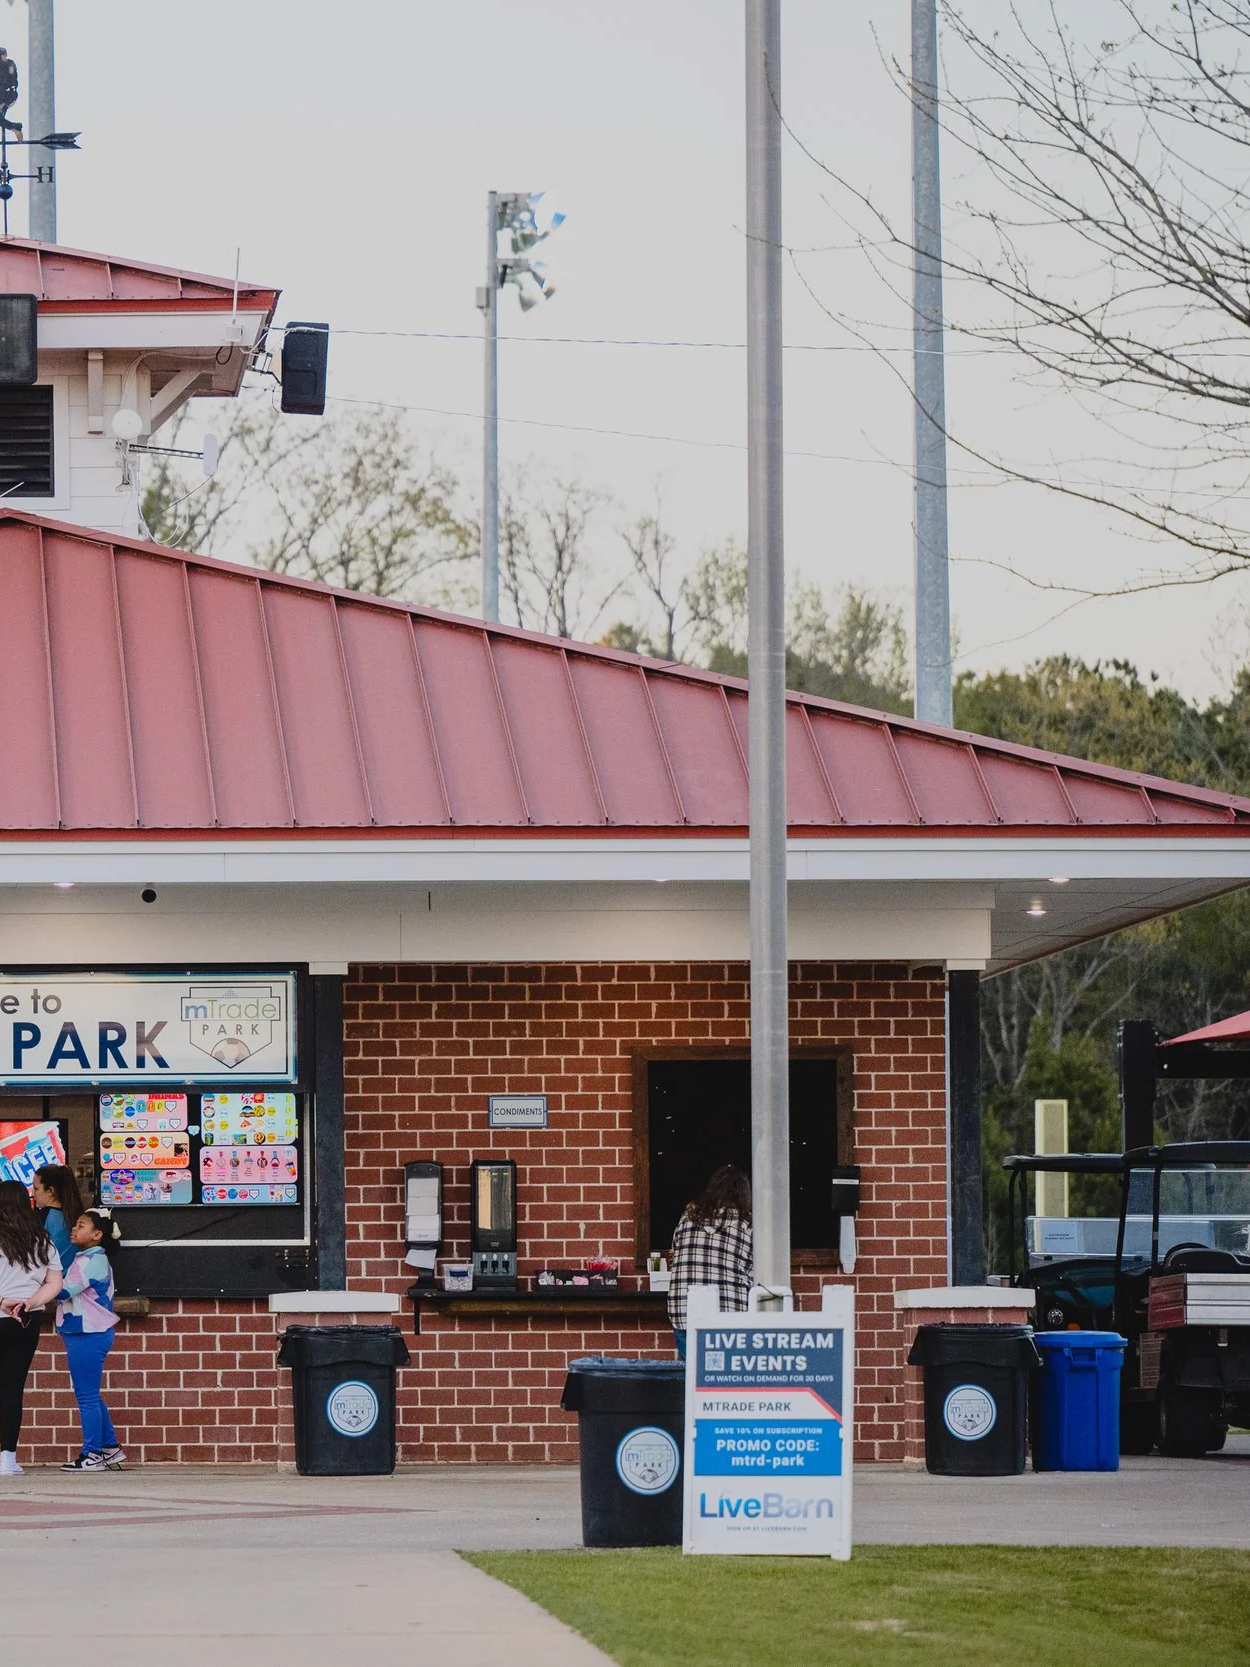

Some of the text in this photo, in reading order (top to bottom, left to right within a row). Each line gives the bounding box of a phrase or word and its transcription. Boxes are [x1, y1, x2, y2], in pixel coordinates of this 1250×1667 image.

[31, 988, 62, 1015] to
[185, 999, 277, 1019] mTrade
[202, 1023, 259, 1036] PARK
[12, 1020, 171, 1070] PARK
[493, 1107, 543, 1116] CONDIMENTS
[154, 1157, 188, 1166] CANDY
[704, 1332, 834, 1349] LIVE STREAM
[730, 1355, 808, 1371] EVENTS
[702, 1401, 791, 1412] MTRADE PARK
[716, 1439, 820, 1452] PROMO CODE:
[731, 1454, 805, 1469] mtrd-park
[700, 1492, 833, 1518] LiveBarn
